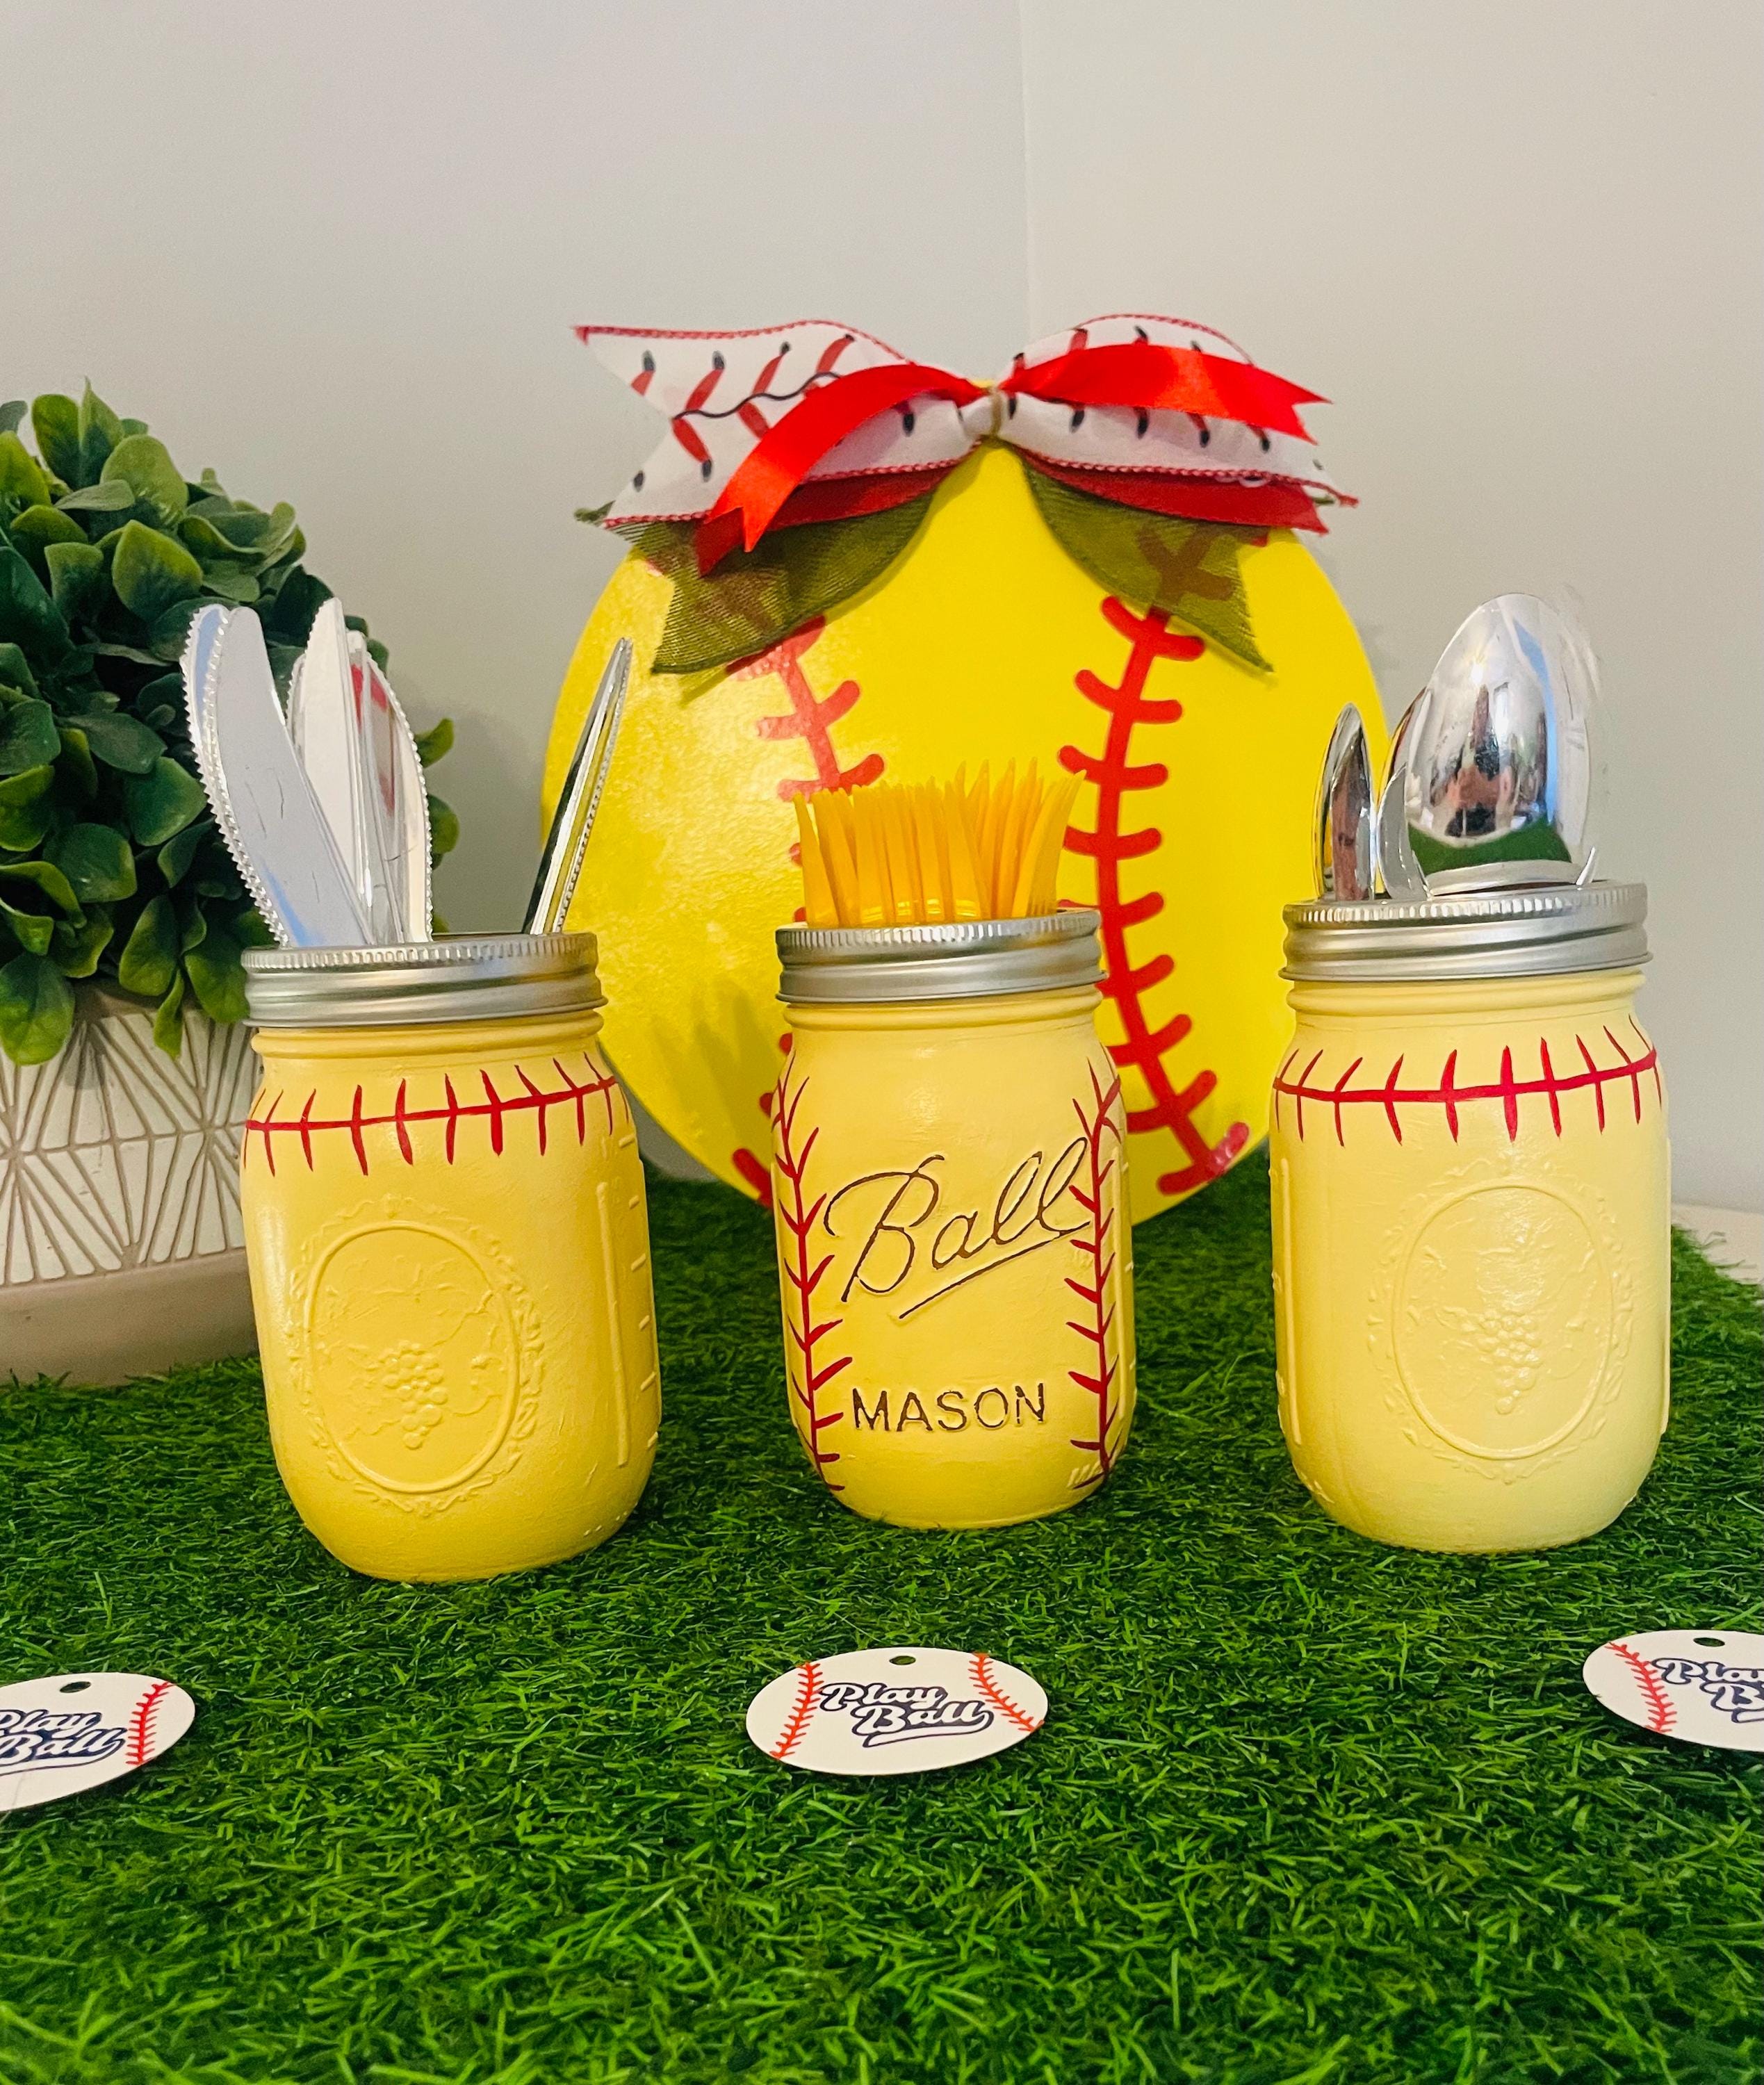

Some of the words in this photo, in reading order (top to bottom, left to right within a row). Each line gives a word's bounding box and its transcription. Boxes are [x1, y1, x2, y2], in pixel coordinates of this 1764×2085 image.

[824, 1137, 1091, 1318] Ball
[852, 1383, 1045, 1432] MASON
[1651, 1658, 1764, 1685] Pla
[819, 1682, 949, 1712] Play
[850, 1700, 995, 1748] Ball
